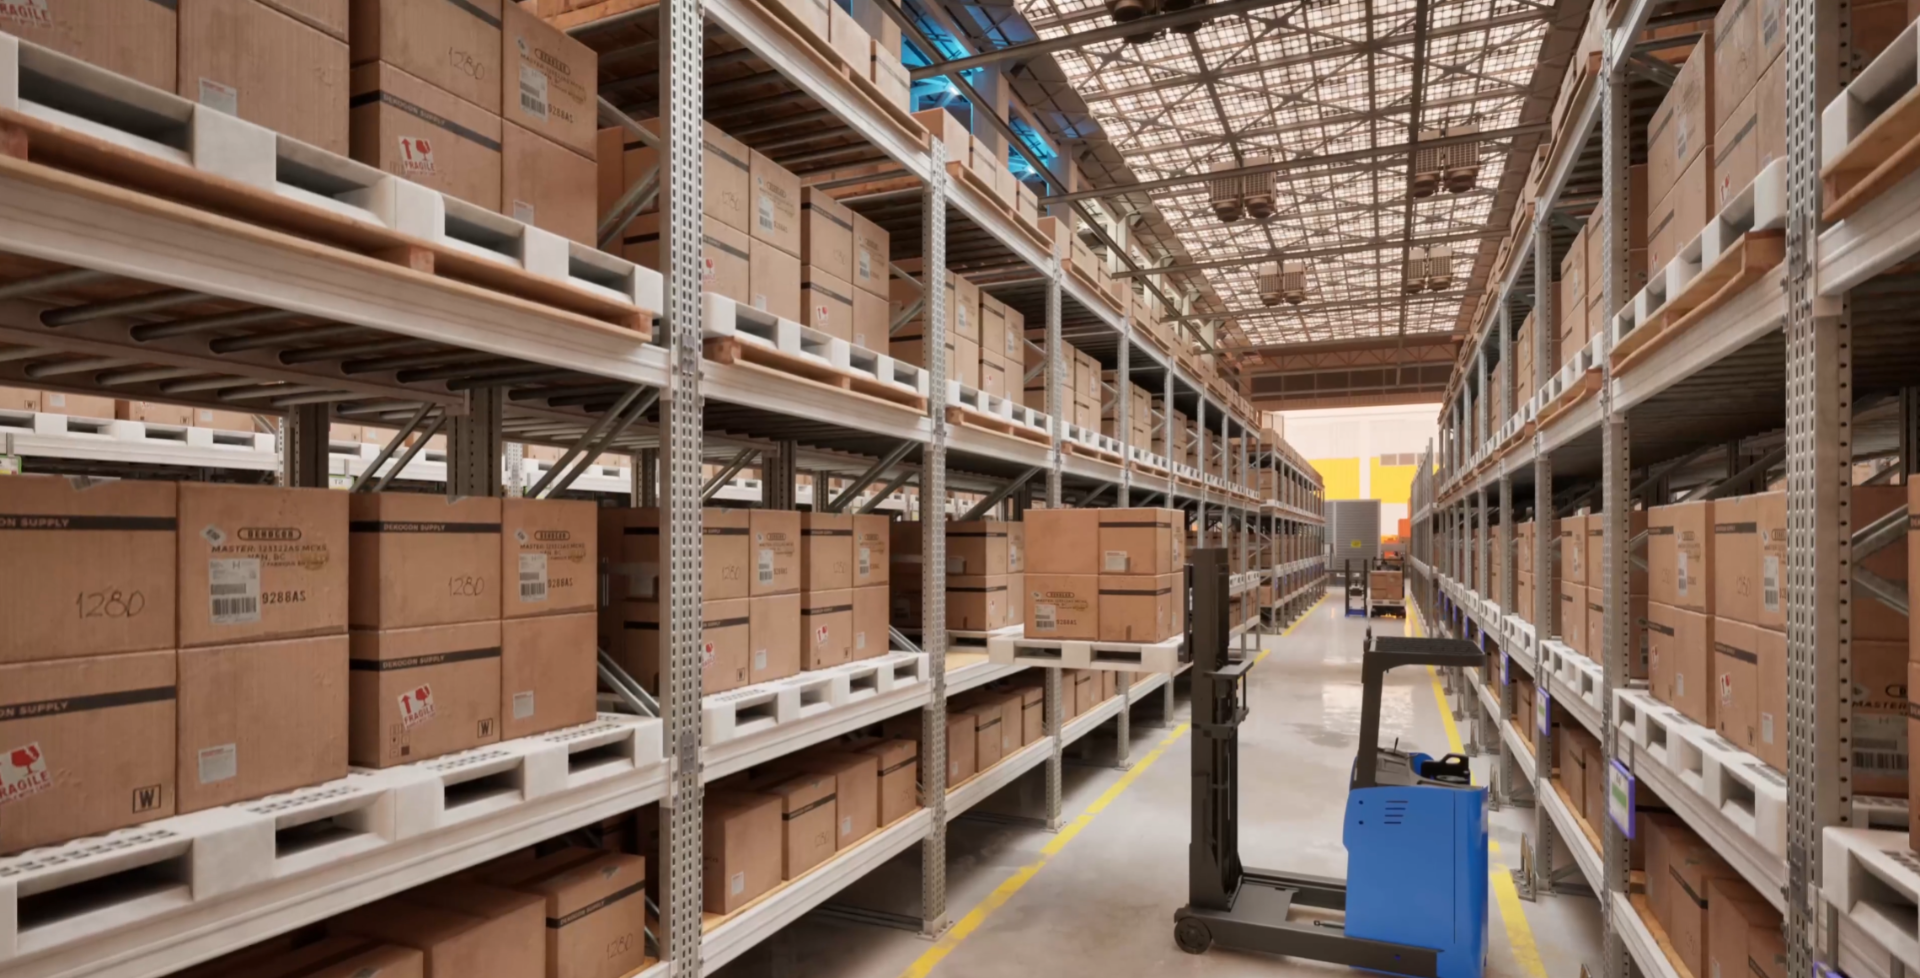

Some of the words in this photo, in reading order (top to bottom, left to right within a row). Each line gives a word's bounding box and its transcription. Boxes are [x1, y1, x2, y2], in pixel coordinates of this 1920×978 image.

[448, 46, 485, 80] 1280
[404, 161, 435, 172] FRAGILE
[20, 517, 70, 528] SUPPLY
[420, 524, 446, 532] SUPPLY
[448, 576, 485, 597] 1280
[76, 588, 146, 619] 1280
[261, 590, 306, 605] 9288AS
[420, 655, 445, 665] SUPPLY
[19, 701, 69, 715] SUPPLY
[404, 704, 435, 725] FRAGILE
[480, 721, 490, 736] W
[139, 788, 155, 809] W
[606, 932, 634, 960] 1280
